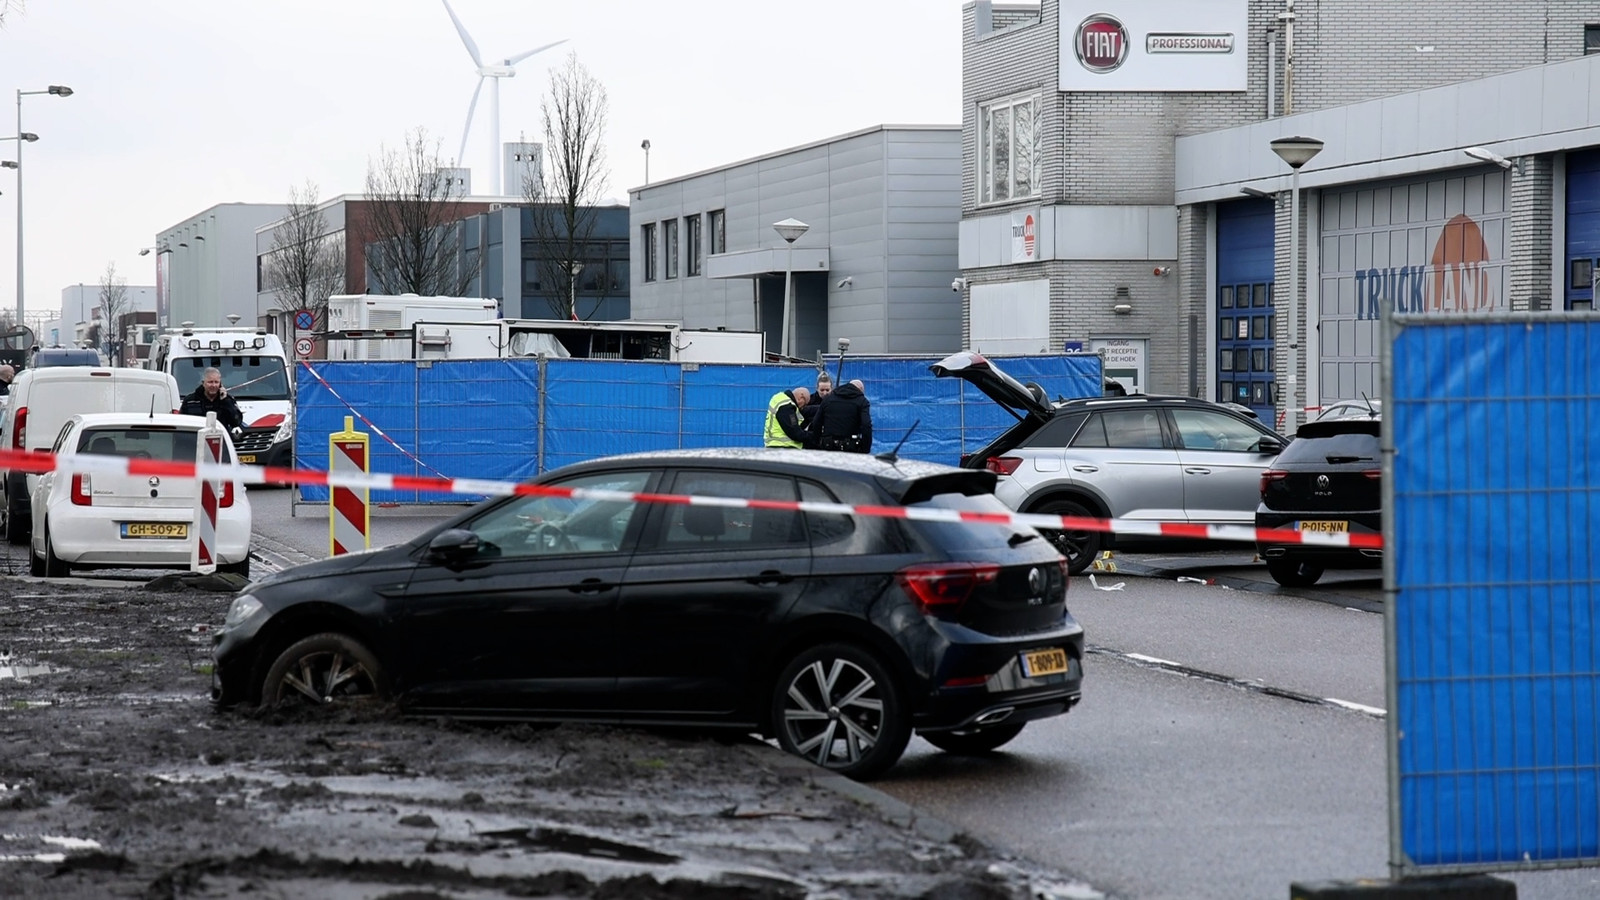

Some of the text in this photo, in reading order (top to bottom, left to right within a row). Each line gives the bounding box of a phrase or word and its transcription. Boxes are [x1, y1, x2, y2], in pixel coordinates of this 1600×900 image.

[1086, 32, 1118, 58] FIAT
[1152, 38, 1228, 49] PROFESSIONAL
[1355, 262, 1496, 321] TRUCKLAND
[298, 343, 311, 351] 30
[130, 524, 184, 535] GH-509-Z
[1302, 522, 1344, 532] P-015-NN
